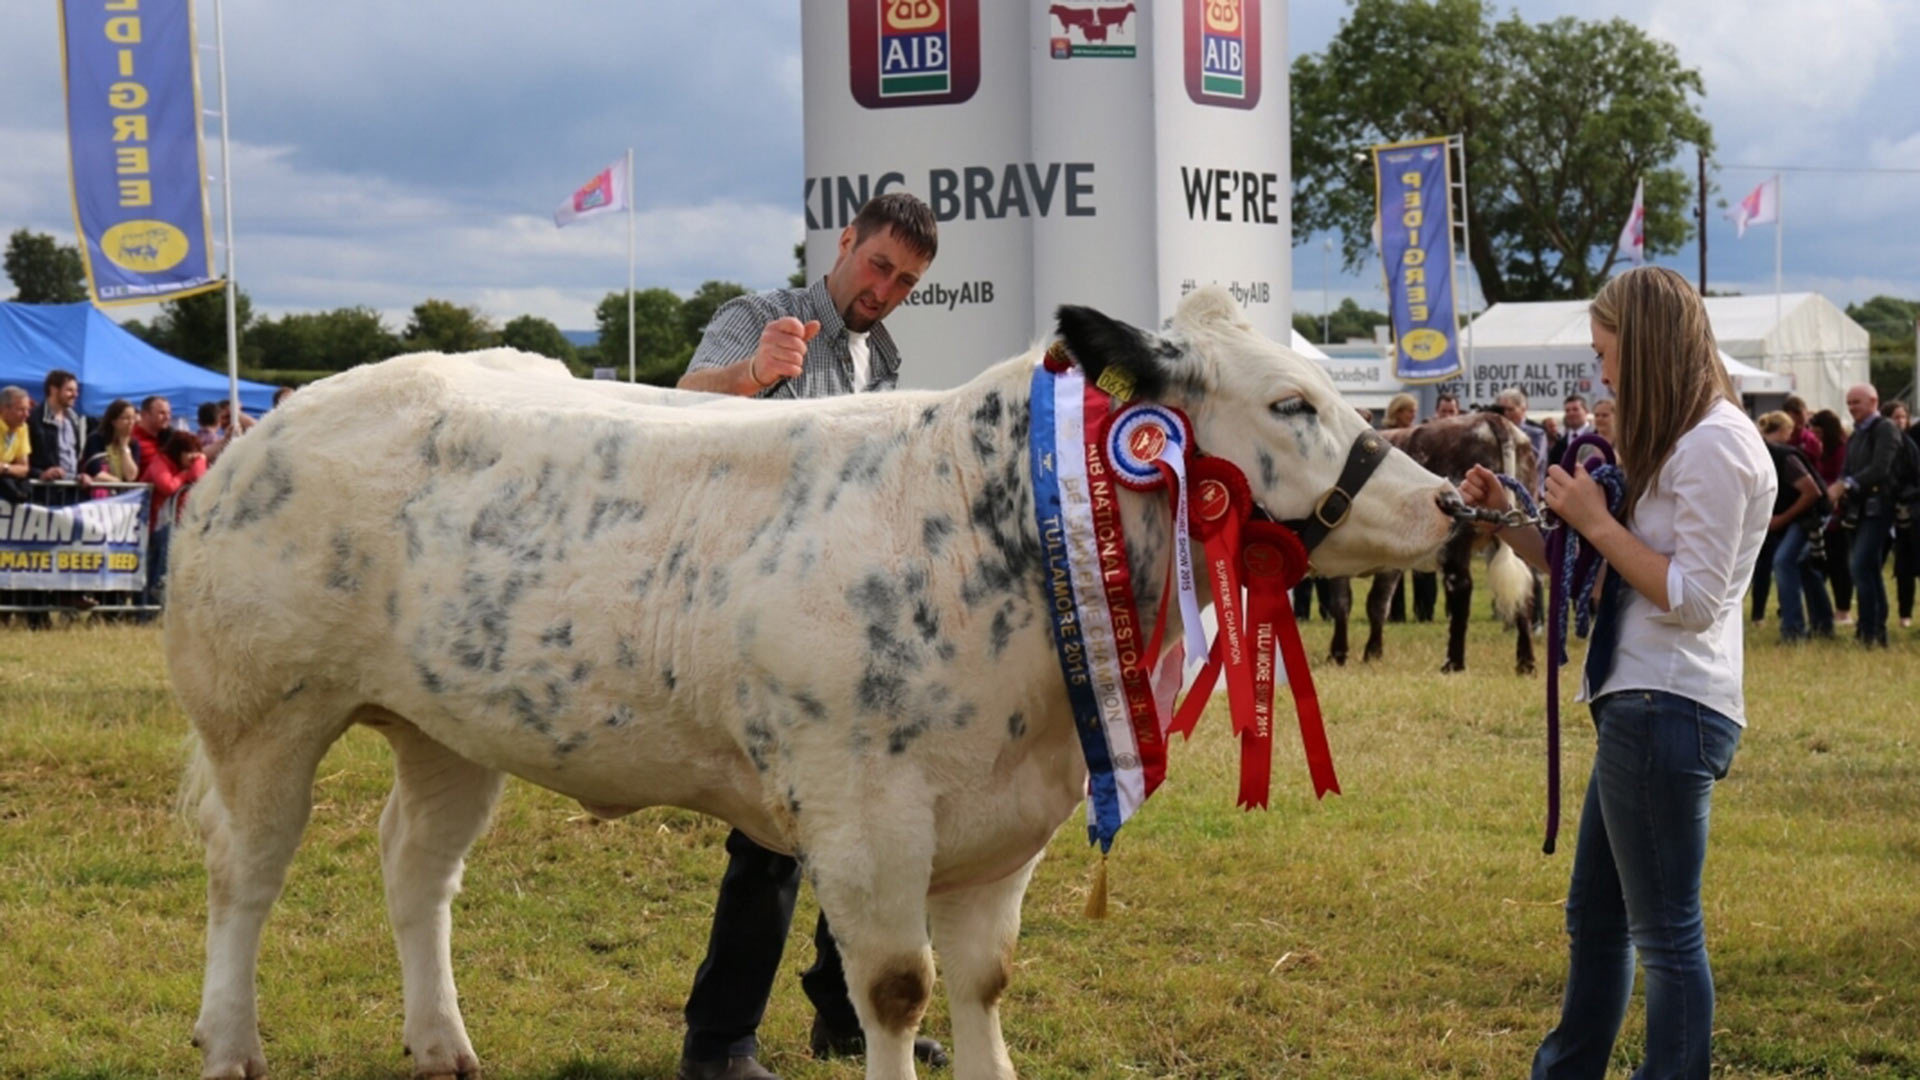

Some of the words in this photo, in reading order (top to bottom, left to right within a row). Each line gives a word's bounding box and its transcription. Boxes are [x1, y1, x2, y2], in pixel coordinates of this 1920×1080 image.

[884, 36, 945, 70] AIB
[1204, 38, 1241, 71] AIB
[929, 163, 1096, 222] BRAVE
[1181, 166, 1279, 224] WE'RE
[1524, 364, 1551, 380] ALL
[1556, 363, 1585, 379] THE
[57, 552, 103, 570] BEEF
[1179, 537, 1188, 567] SHOW
[1181, 569, 1192, 591] 2015
[1216, 559, 1233, 609] SUPREME
[1044, 514, 1077, 638] TULLAMORE
[1064, 641, 1087, 686] 2015
[1092, 481, 1121, 582] NATIONAL
[1108, 586, 1141, 690] LIVESTOCK
[1130, 694, 1154, 743] SHOW
[1224, 610, 1242, 666] CHAMPION
[1090, 626, 1122, 722] CHAMPION
[1256, 683, 1270, 713] SHOW
[1256, 714, 1269, 738] 2015
